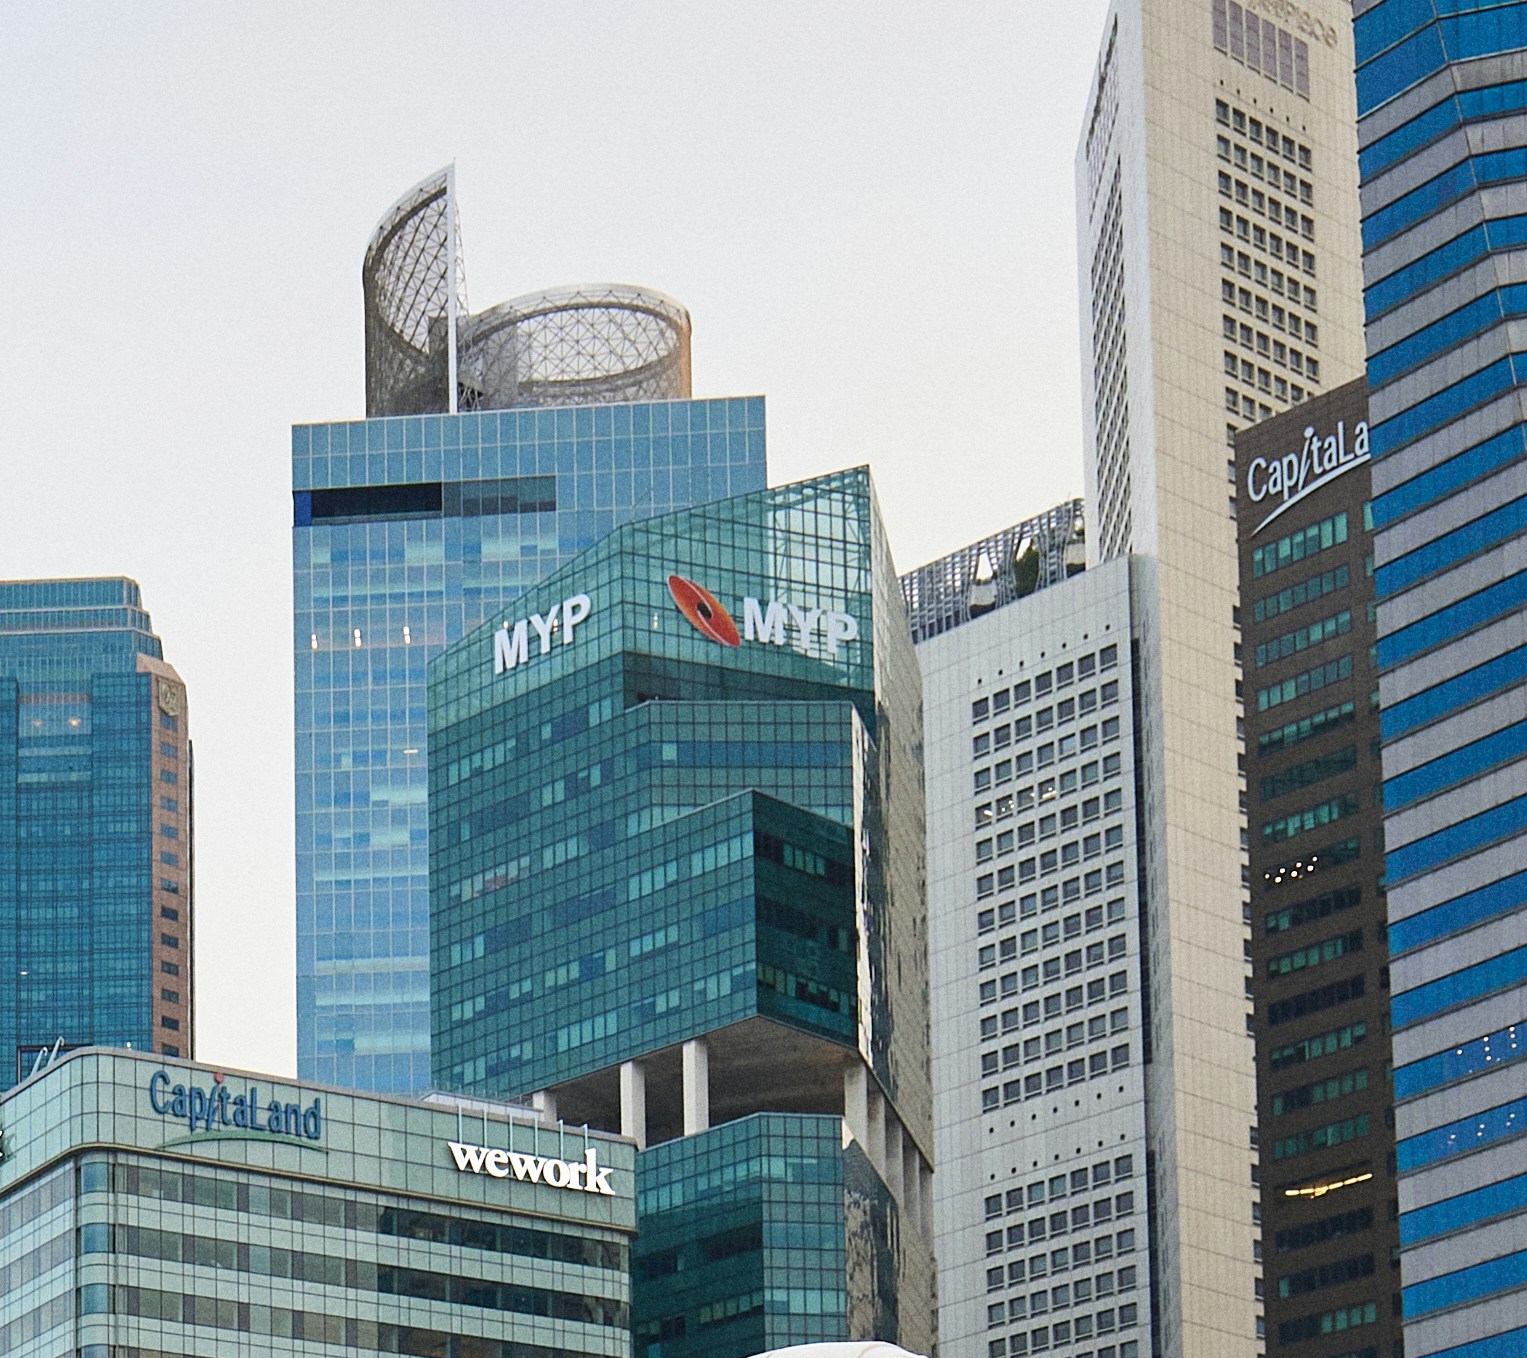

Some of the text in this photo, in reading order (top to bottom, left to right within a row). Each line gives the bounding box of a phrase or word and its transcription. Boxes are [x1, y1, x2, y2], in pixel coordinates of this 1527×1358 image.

[494, 593, 592, 675] MYP
[744, 596, 858, 655] MYP
[149, 1069, 322, 1140] CapitaLand
[447, 1141, 616, 1196] wework
